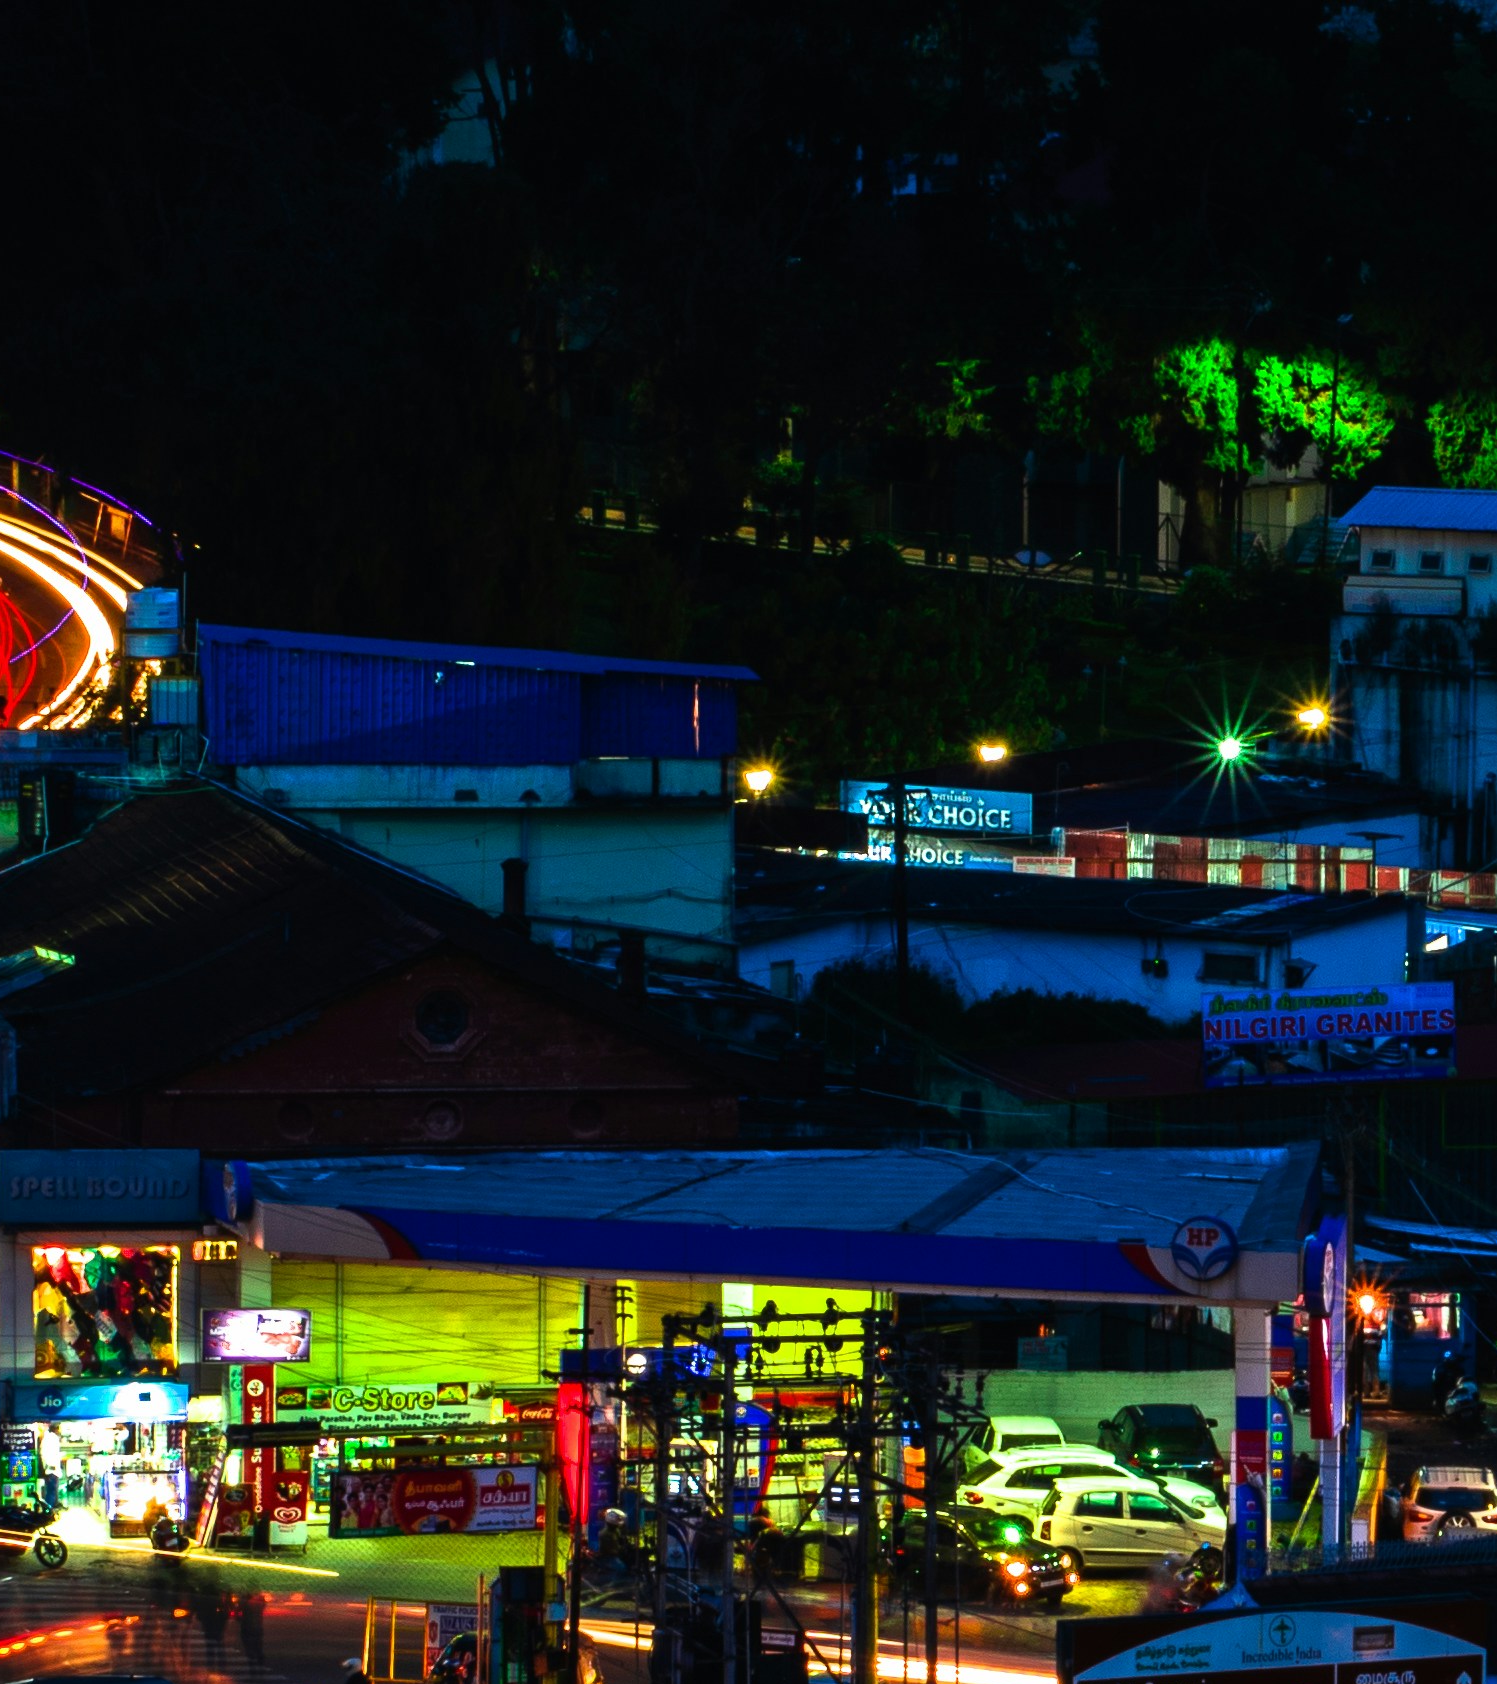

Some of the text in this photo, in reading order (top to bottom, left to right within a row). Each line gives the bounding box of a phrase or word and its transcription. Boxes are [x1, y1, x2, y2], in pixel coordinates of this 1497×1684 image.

[928, 803, 1012, 829] CHOICE
[1203, 1008, 1456, 1042] NILGIRI GRANITES
[9, 1175, 192, 1199] SPELL BOUND
[1187, 1227, 1219, 1247] HP
[39, 1394, 63, 1409] Jio
[334, 1386, 436, 1412] C-Store
[1241, 1646, 1294, 1665] Incredible
